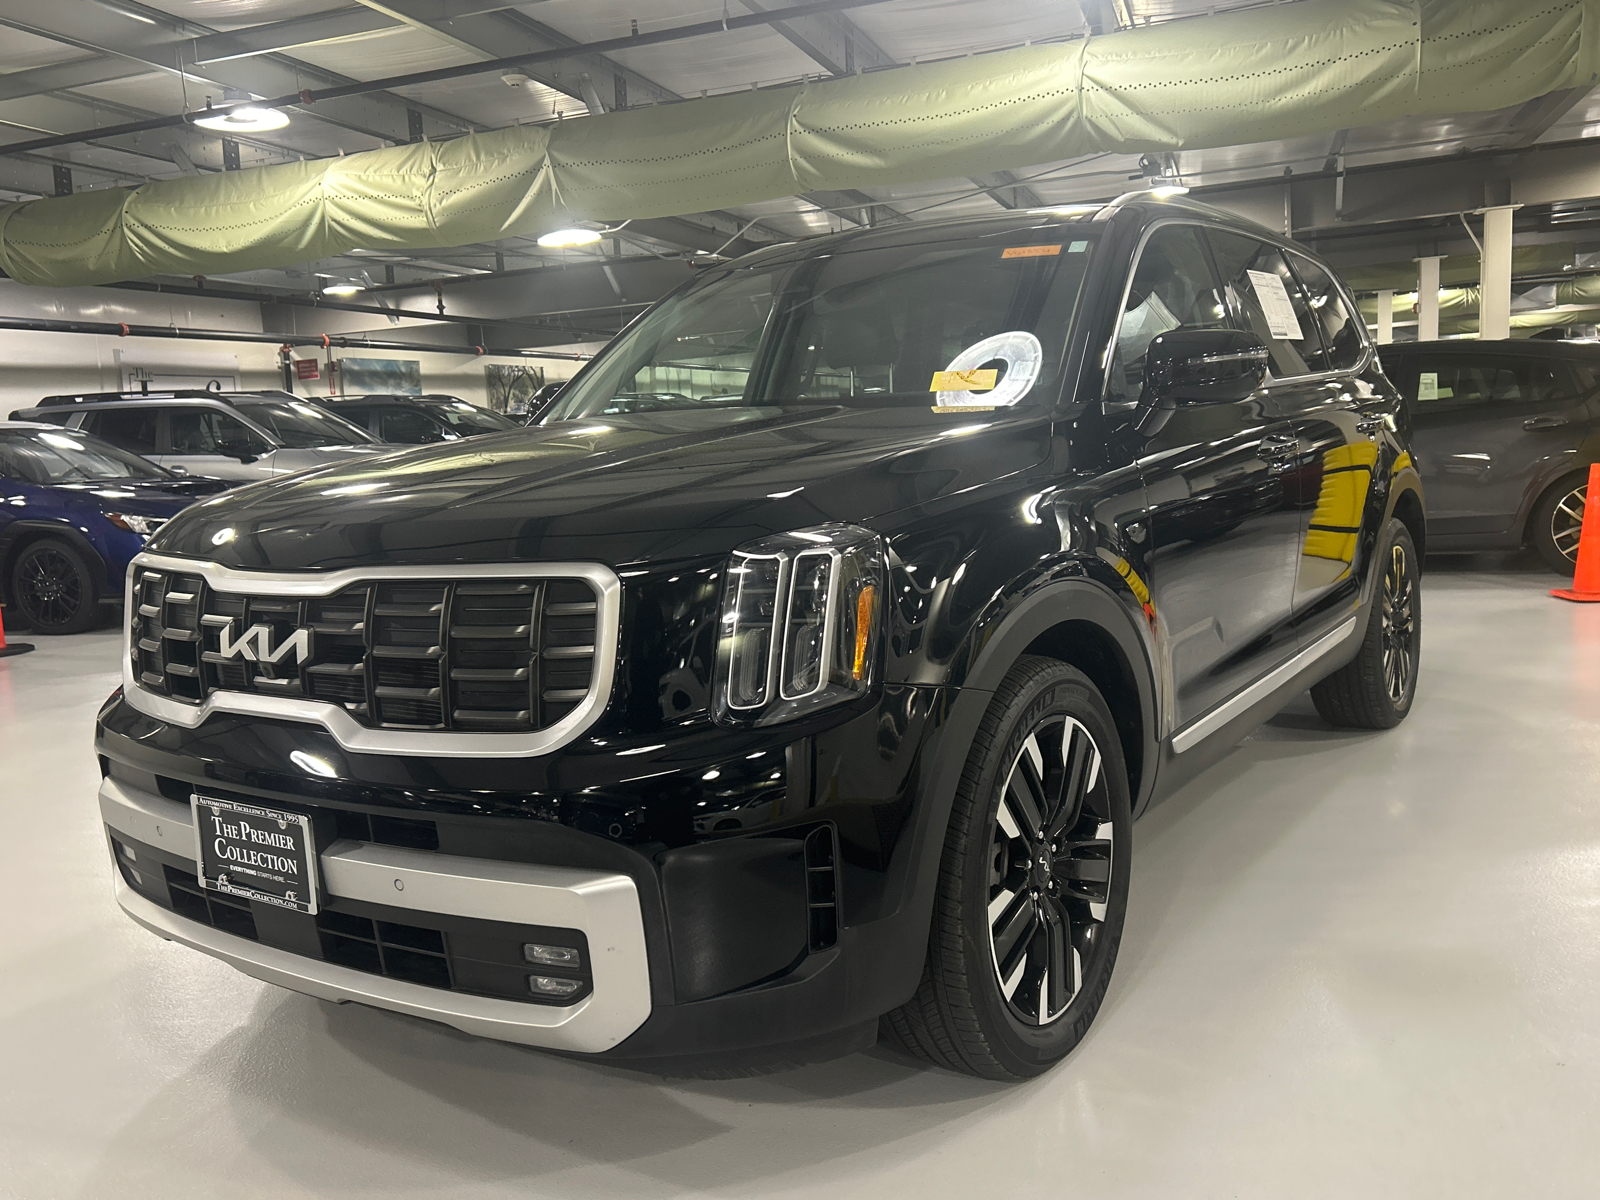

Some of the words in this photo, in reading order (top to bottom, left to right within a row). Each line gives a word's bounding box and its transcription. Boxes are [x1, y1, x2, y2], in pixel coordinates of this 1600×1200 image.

[132, 367, 154, 379] The
[219, 619, 313, 666] KIA
[1001, 689, 1053, 781] MICHELIN
[211, 816, 239, 840] THE
[240, 821, 295, 851] PREMIER
[284, 813, 298, 823] 1995
[214, 838, 297, 875] COLLECTION
[229, 865, 256, 876] EVERYTHING
[257, 871, 272, 880] STARTS
